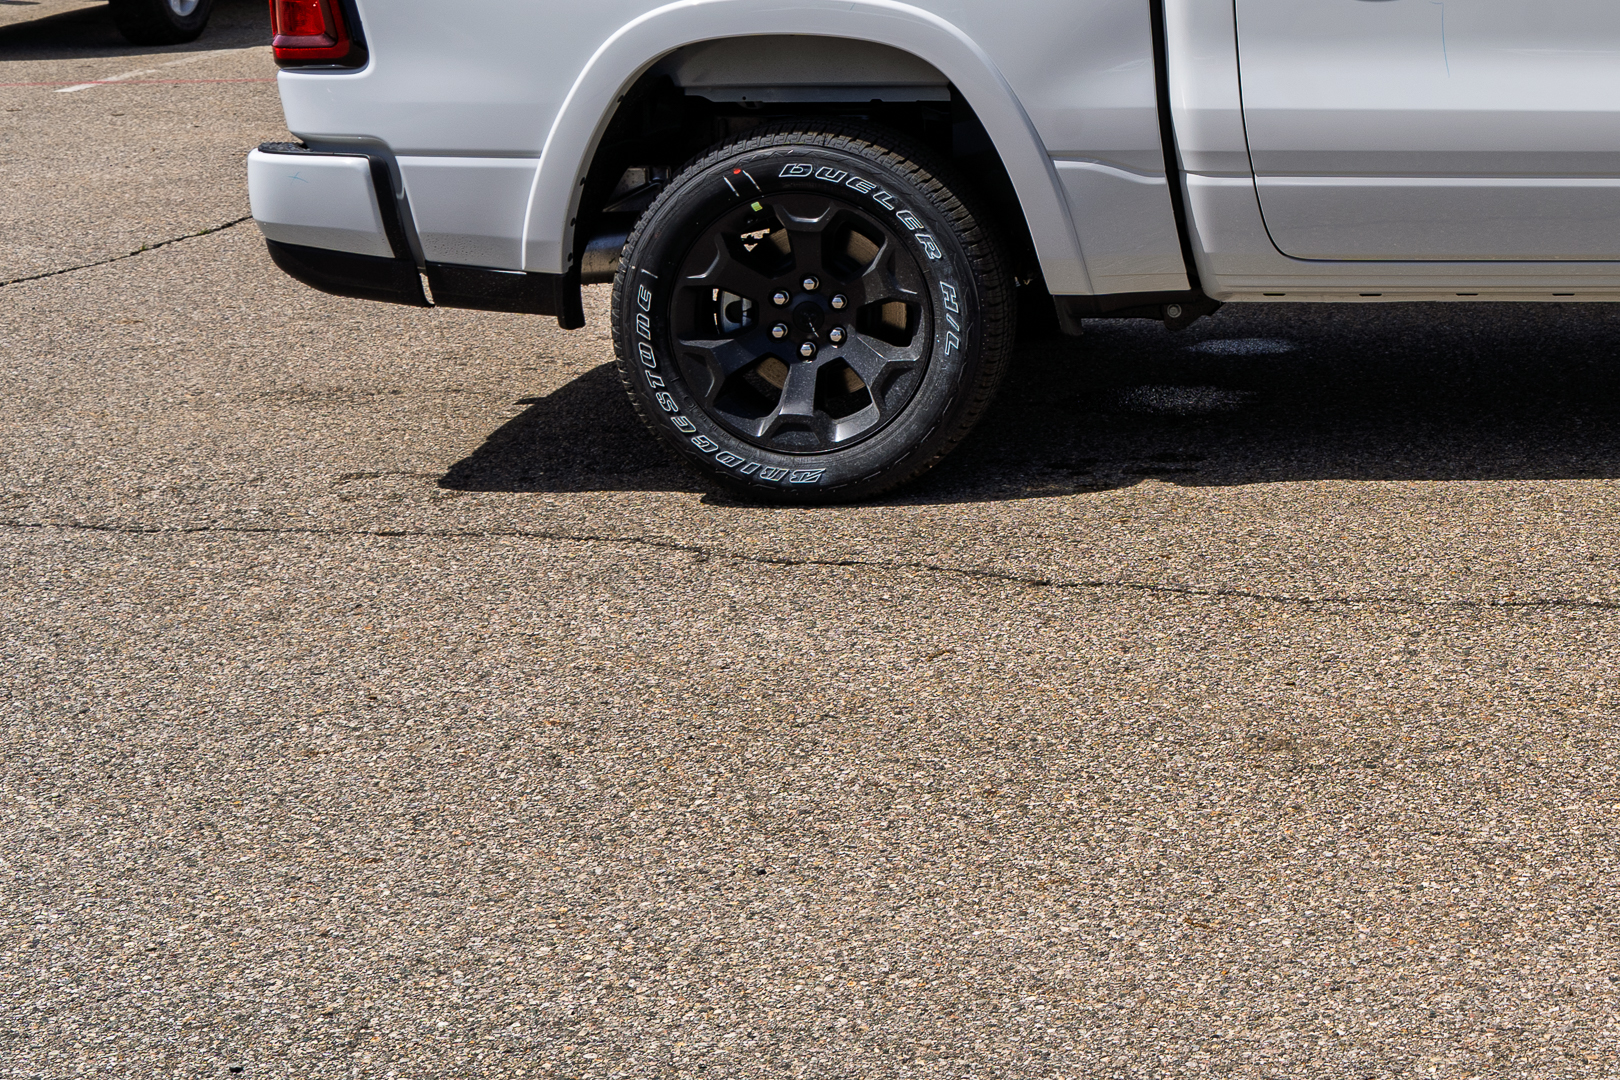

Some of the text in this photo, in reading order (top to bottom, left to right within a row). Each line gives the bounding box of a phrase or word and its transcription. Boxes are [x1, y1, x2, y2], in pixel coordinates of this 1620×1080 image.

[778, 163, 943, 261] DUELER
[940, 280, 966, 356] H/L
[636, 284, 827, 484] BRIDGESTONE
